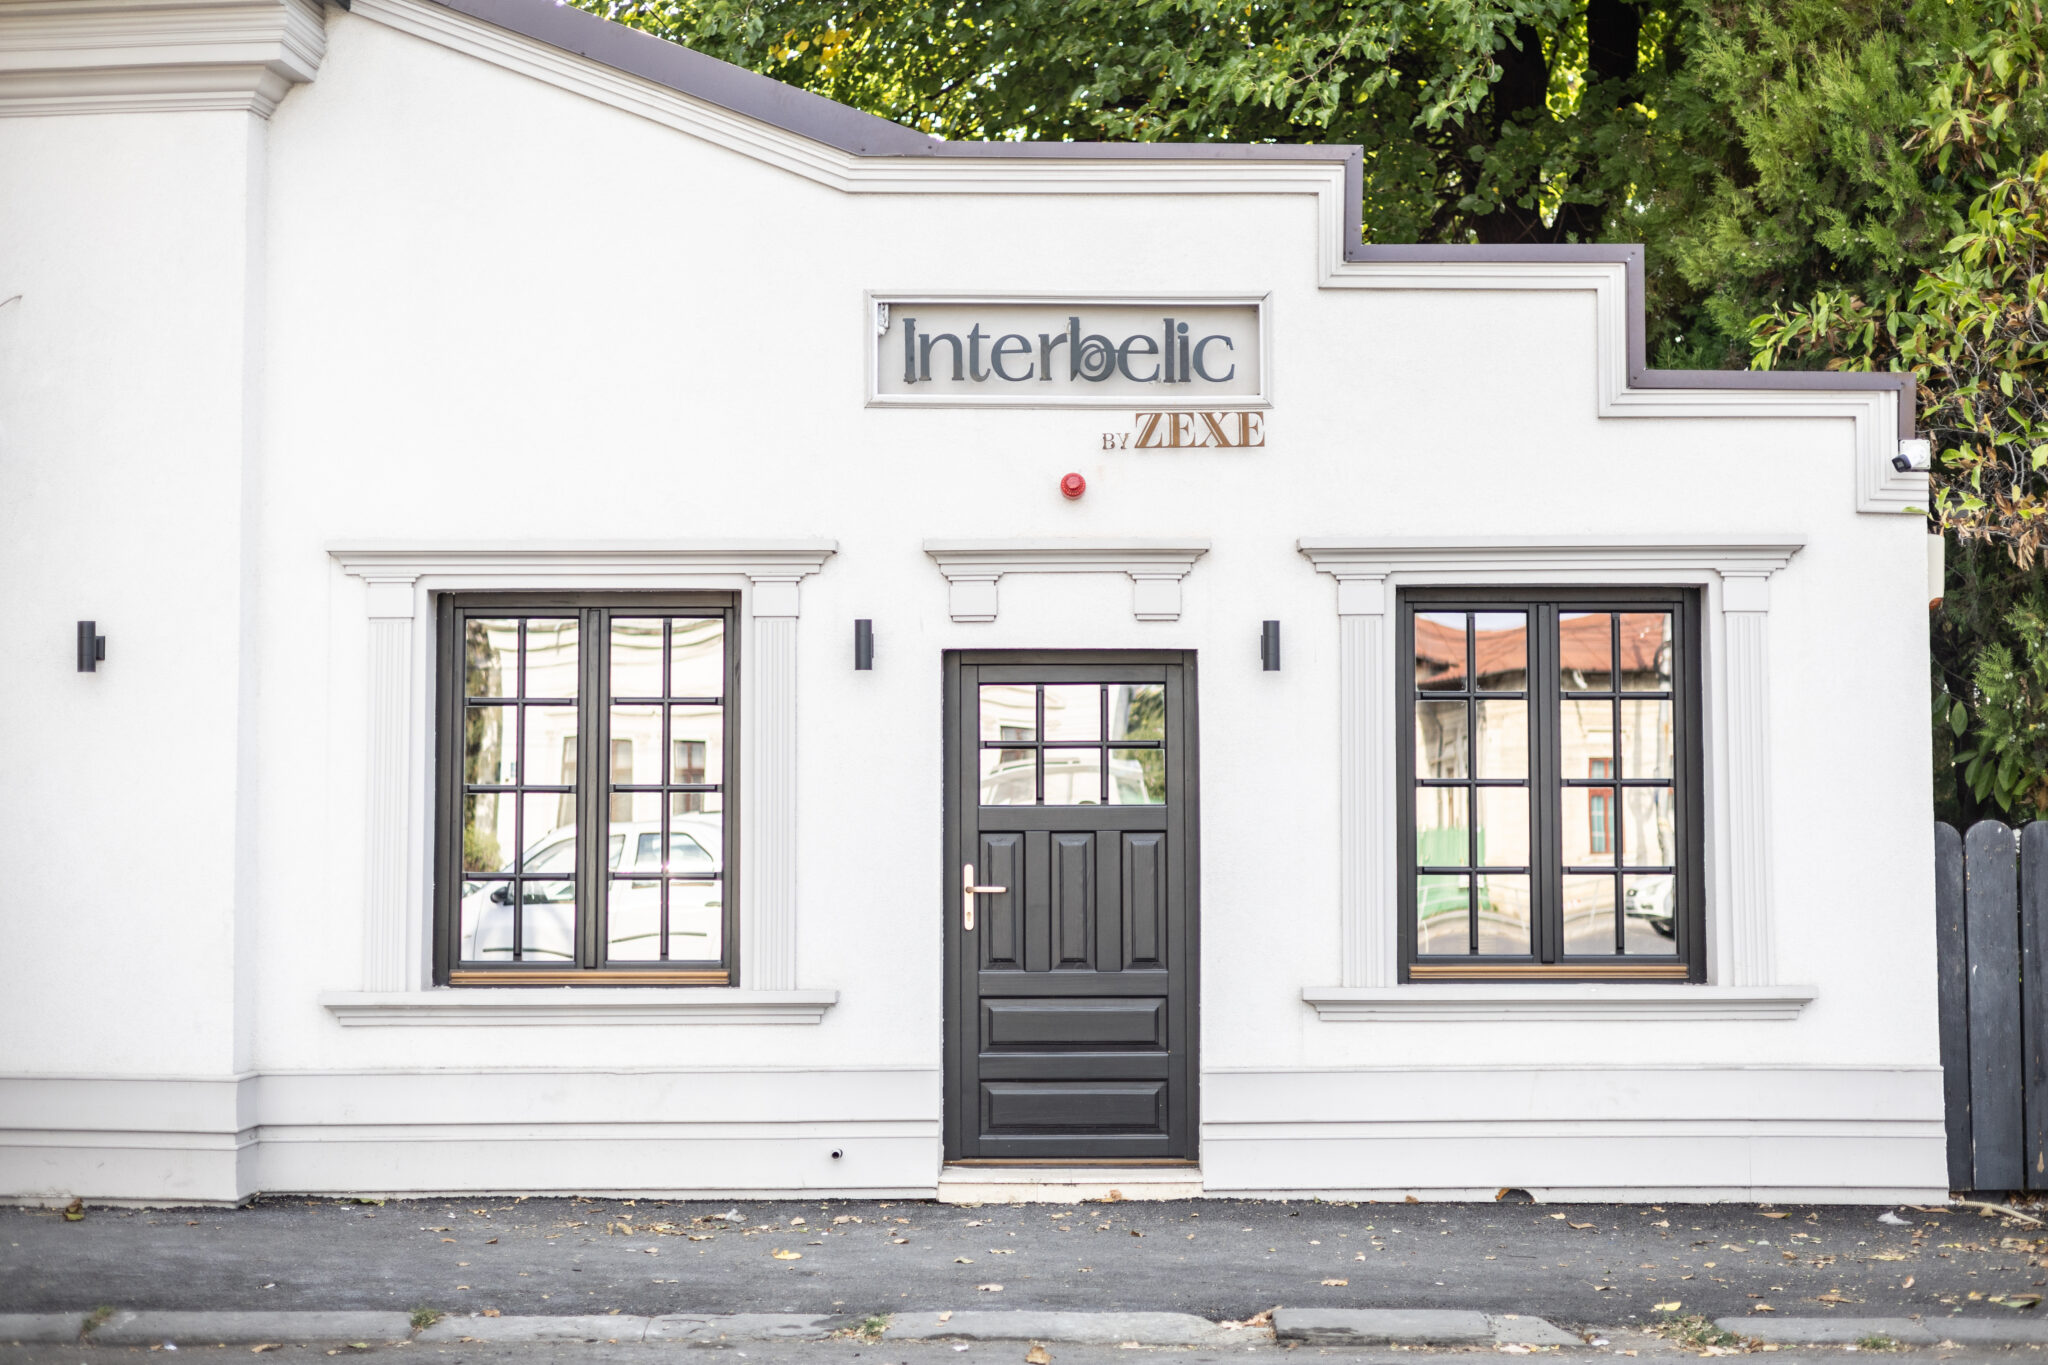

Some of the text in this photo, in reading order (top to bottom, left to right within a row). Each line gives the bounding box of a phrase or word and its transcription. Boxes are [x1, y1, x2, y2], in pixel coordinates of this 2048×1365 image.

[902, 316, 1235, 384] Interbelic
[1102, 411, 1265, 450] BY ZEXE
